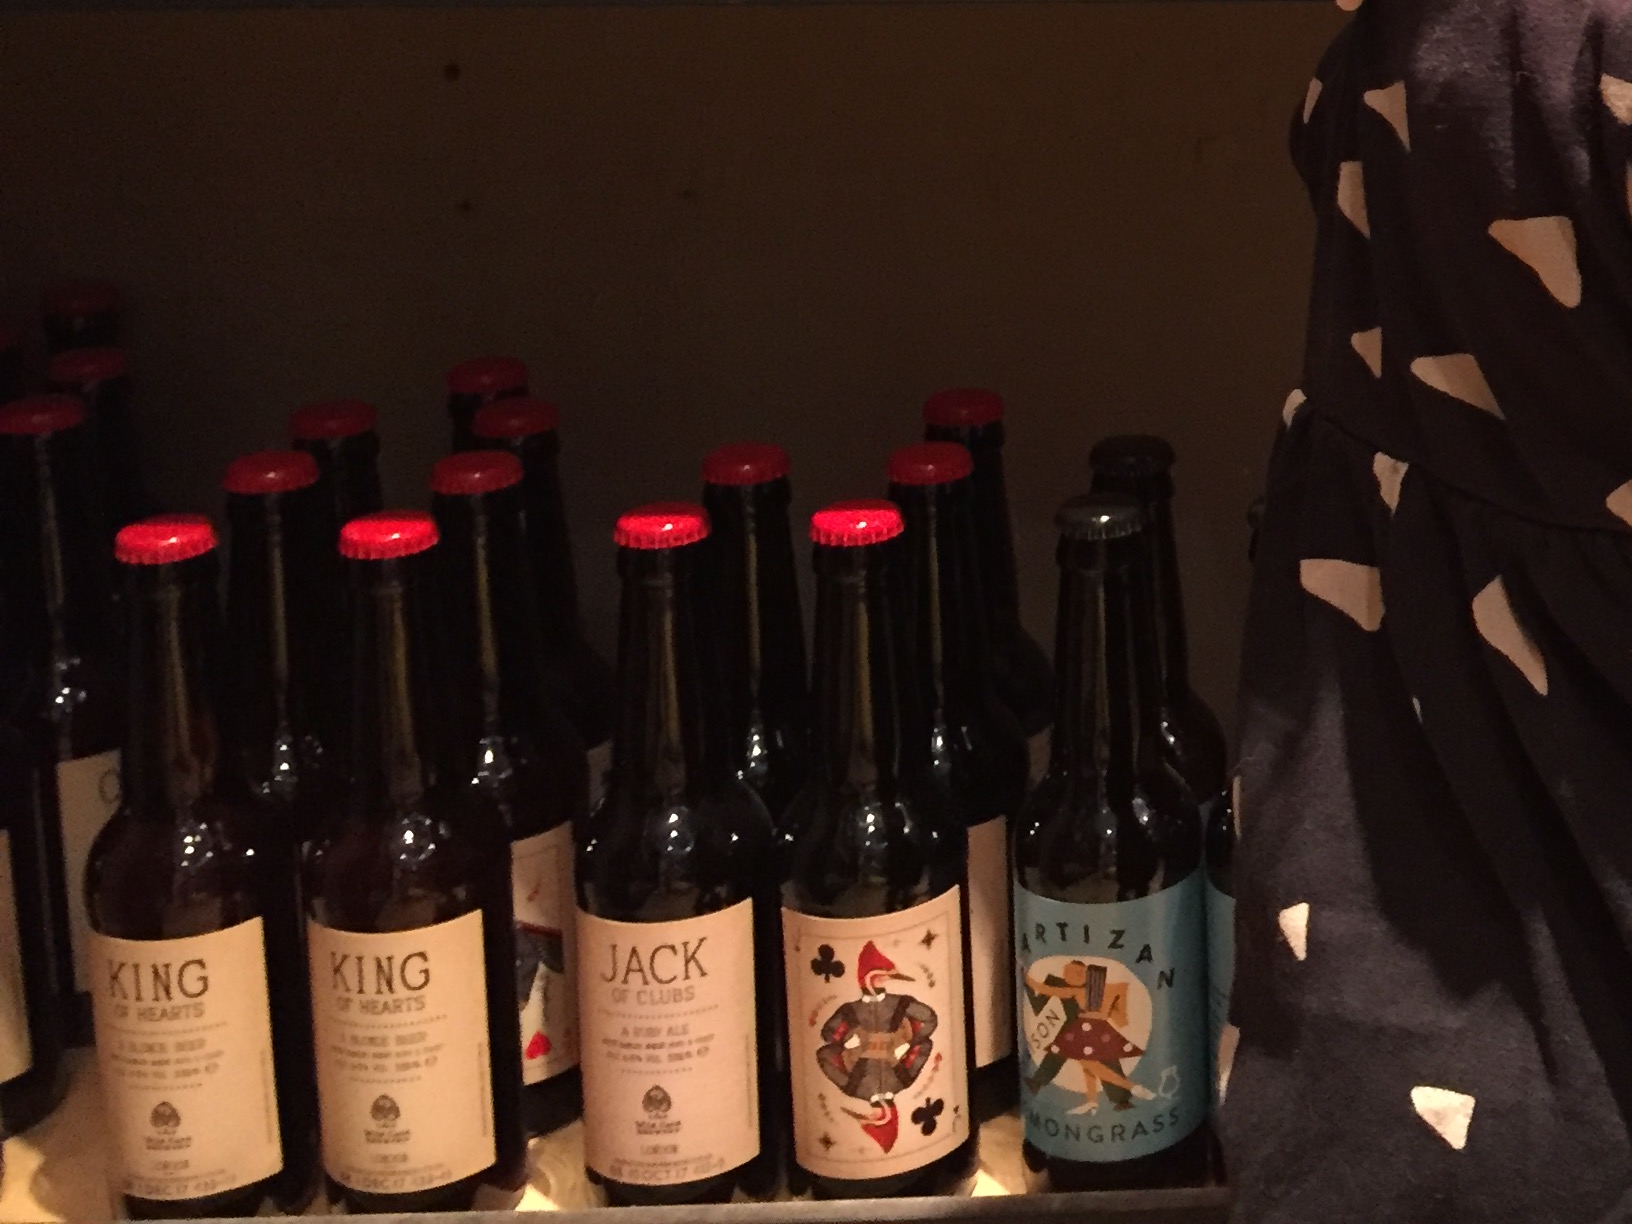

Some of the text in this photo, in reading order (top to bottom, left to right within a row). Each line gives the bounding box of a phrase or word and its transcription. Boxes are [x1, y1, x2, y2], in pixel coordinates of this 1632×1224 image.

[330, 951, 430, 994] KING
[600, 936, 708, 985] JACK
[1021, 922, 1175, 990] ARTIZAN
[106, 959, 209, 1002] KING
[611, 985, 695, 1006] OF CLUBS
[359, 994, 425, 1015] HEARTS
[1031, 1009, 1060, 1049] SON
